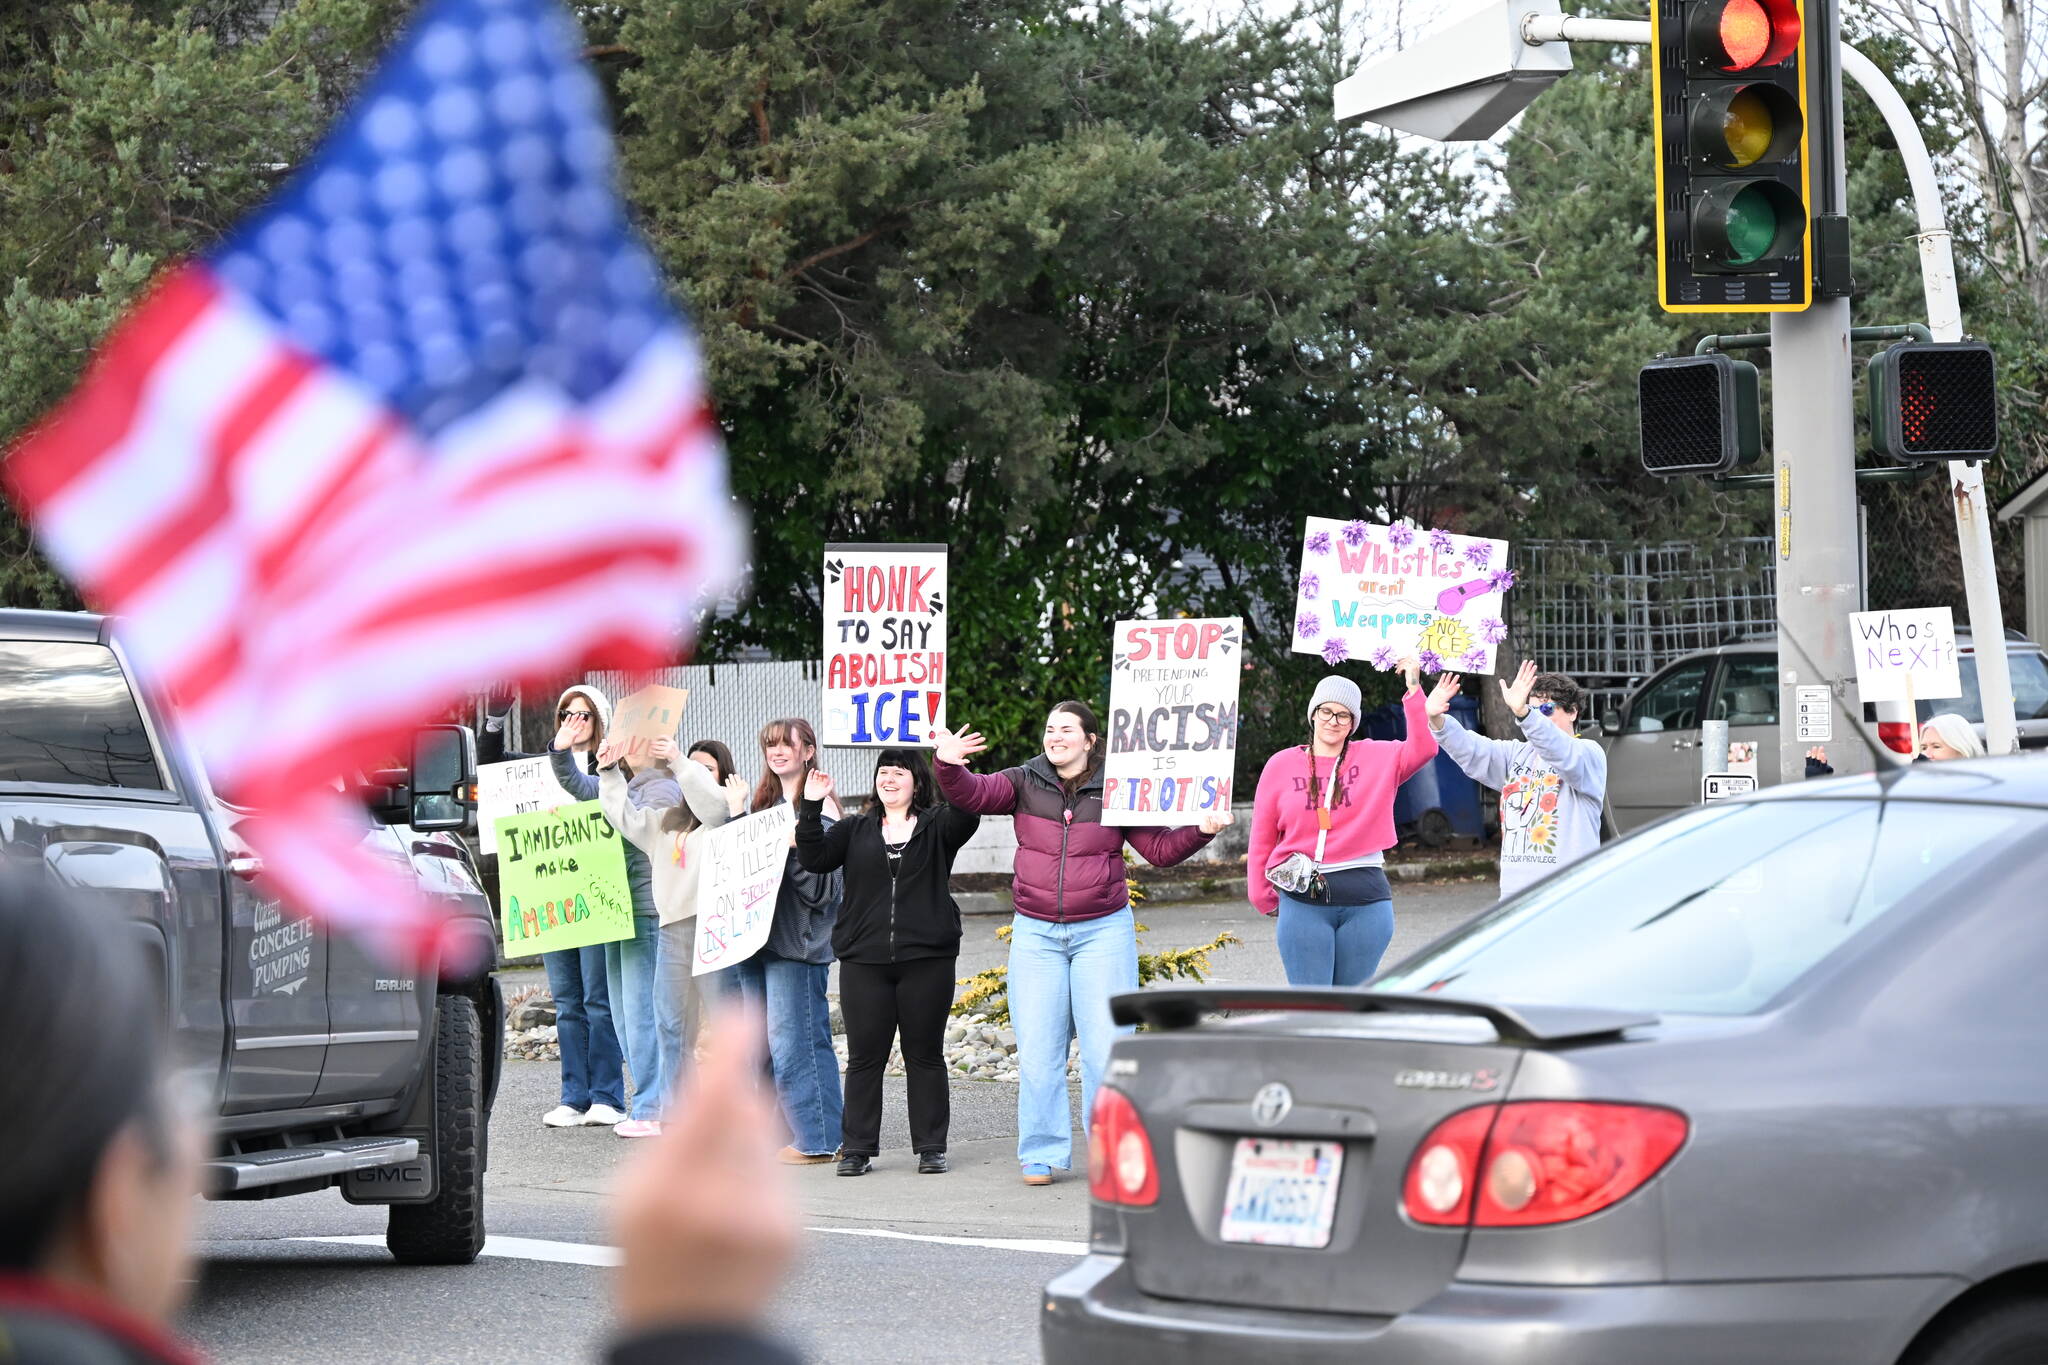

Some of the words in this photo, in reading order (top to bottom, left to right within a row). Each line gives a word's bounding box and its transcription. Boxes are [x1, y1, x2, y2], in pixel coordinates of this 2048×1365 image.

[1336, 540, 1465, 578] Whistles
[844, 566, 936, 614] HONK
[1358, 578, 1405, 596] arent
[838, 619, 870, 644] TO
[881, 617, 932, 650] SAY
[1332, 600, 1432, 638] Weapons
[1436, 622, 1456, 636] NO
[1857, 614, 1934, 641] Whos
[1126, 623, 1222, 662] STOP
[1426, 634, 1464, 652] ICE
[828, 652, 944, 690] ABOLISH
[1133, 667, 1208, 683] PRETENDING
[1156, 684, 1194, 704] YOUR
[851, 690, 942, 742] ICE!
[1111, 700, 1236, 754] RACISM
[506, 762, 542, 782] FIGHT
[1152, 756, 1176, 770] IS
[516, 800, 540, 814] NOT
[1102, 776, 1231, 812] PATRIOTISM
[504, 812, 614, 862] IMMIGRANTS
[736, 809, 786, 848] HUMAN
[536, 858, 579, 880] make
[508, 893, 590, 942] AMERICA
[590, 881, 631, 922] GREAT
[716, 890, 735, 918] ON
[251, 914, 312, 960] CONCRETE
[256, 946, 310, 987] PUMPING
[356, 1168, 423, 1182] GMC
